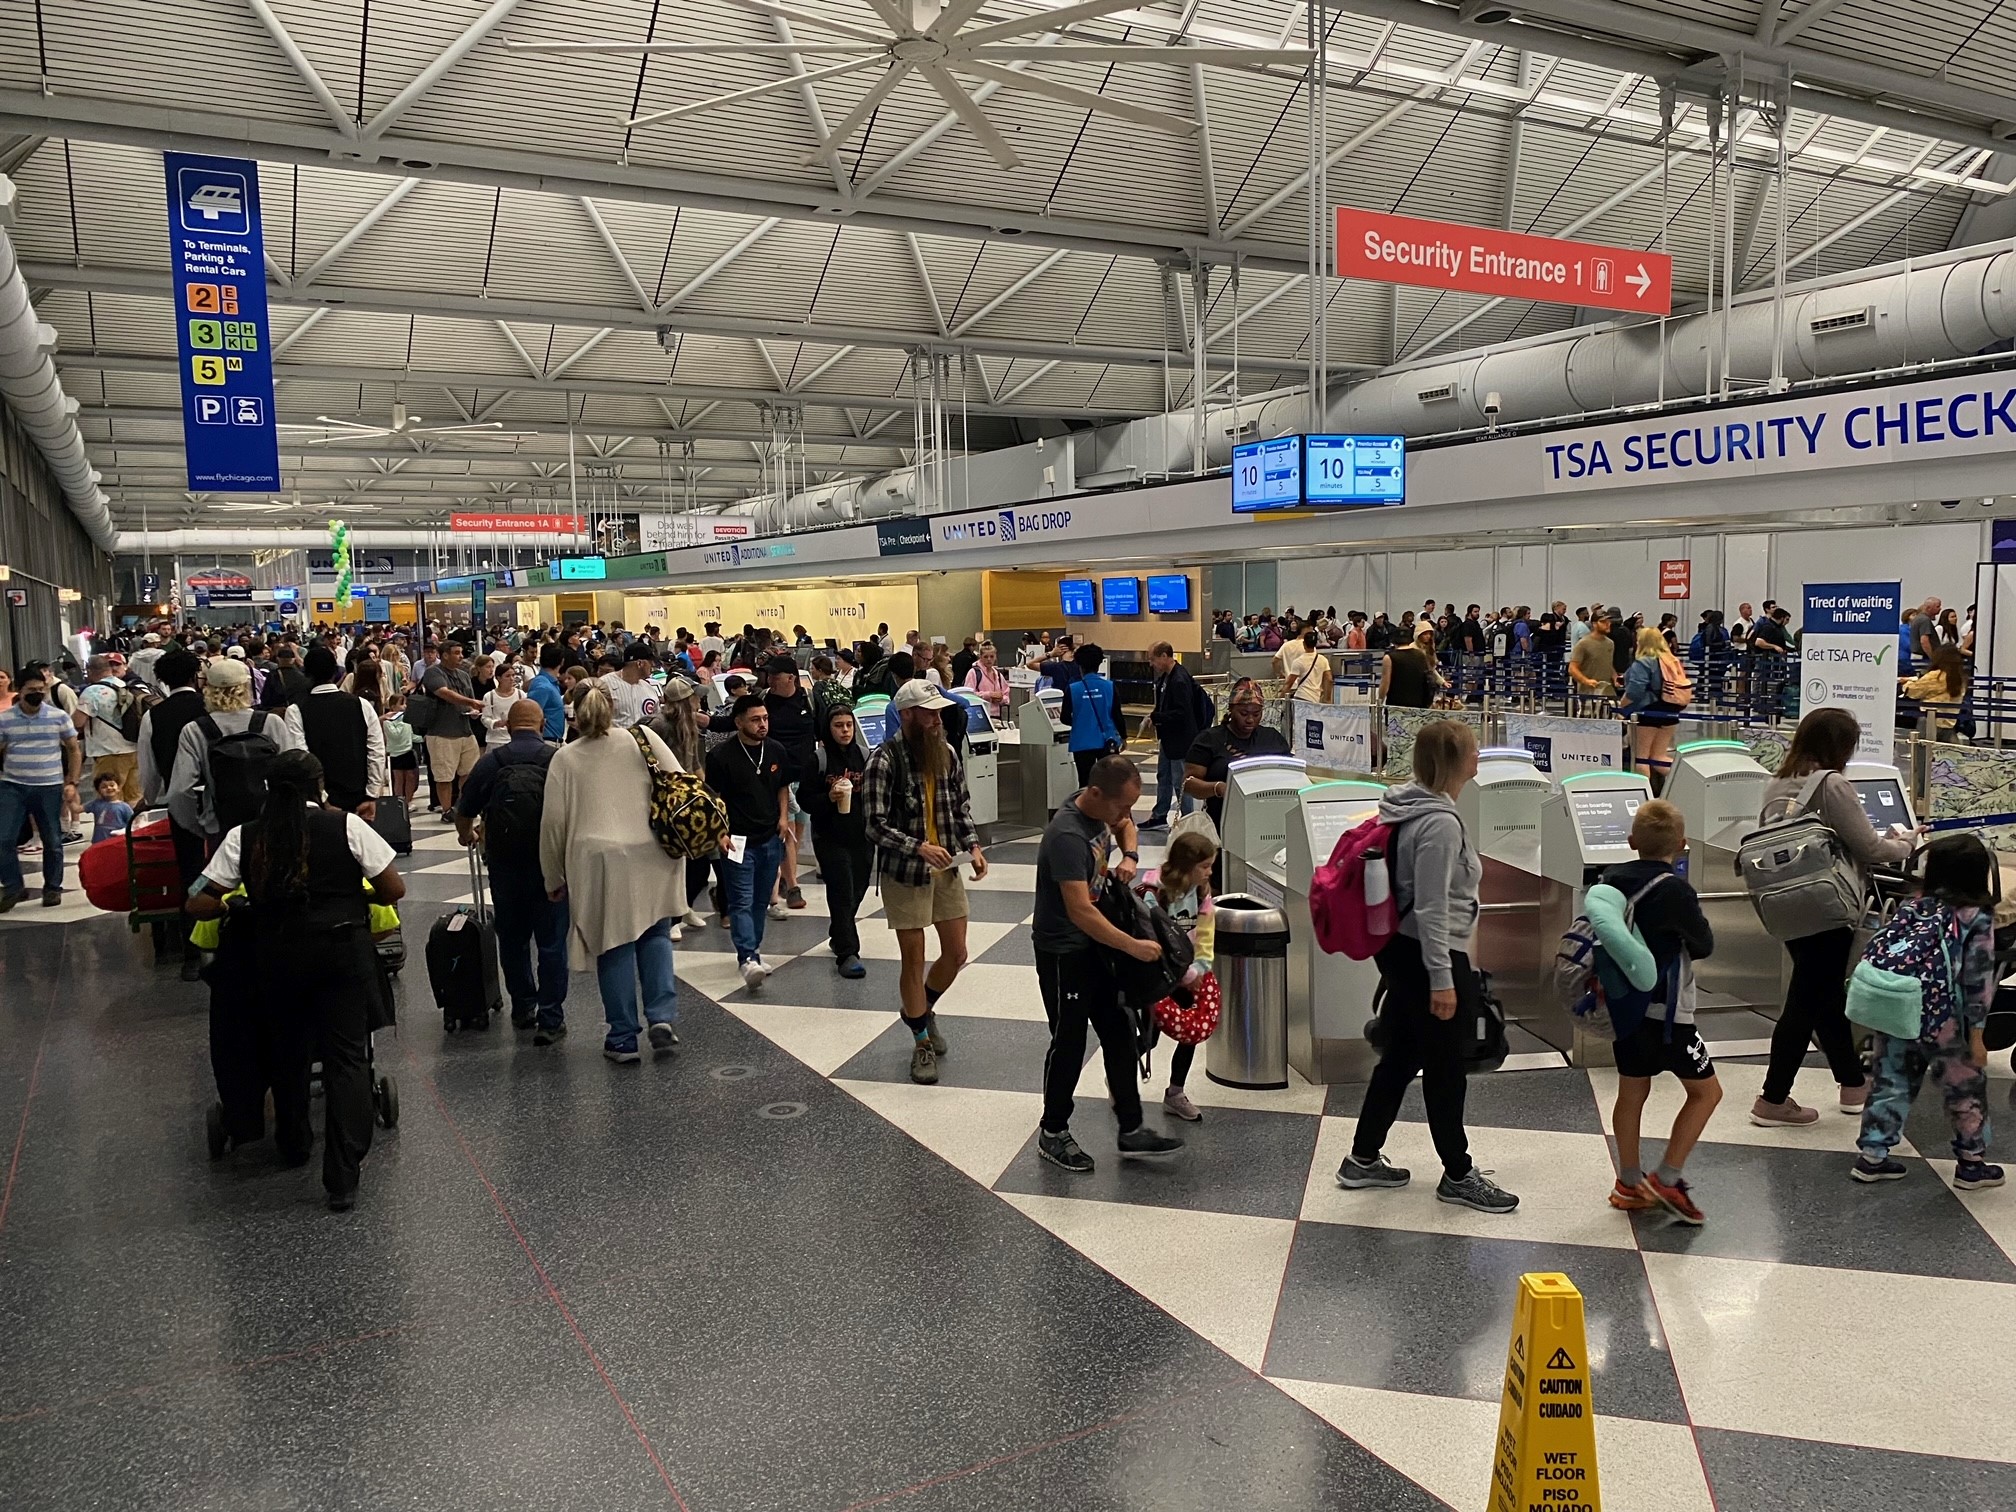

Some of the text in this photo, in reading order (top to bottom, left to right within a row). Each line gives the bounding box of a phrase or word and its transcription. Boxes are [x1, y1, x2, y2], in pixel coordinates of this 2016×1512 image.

[183, 240, 251, 254] To Terminals,
[184, 252, 235, 265] Parking &
[1363, 230, 1582, 286] Security Entrance 1
[185, 263, 246, 276] Rental Cars
[195, 287, 234, 308] 2 E
[226, 302, 235, 312] F
[197, 323, 253, 344] 3 G H
[228, 339, 254, 349] K L
[200, 359, 241, 380] 5 M
[201, 399, 221, 421] P
[1545, 387, 2016, 480] TSA SECURITY CHECK
[1278, 453, 1283, 463] 5
[1375, 450, 1381, 460] 5
[1319, 458, 1344, 480] 10
[195, 473, 273, 482] www.flychicago.com
[1241, 466, 1258, 487] 10
[1278, 481, 1283, 491] 5
[1375, 478, 1381, 488] 5
[456, 519, 493, 528] Security
[495, 519, 535, 528] Entrance
[943, 511, 1071, 541] UNITED BAG DROP
[879, 537, 888, 546] TSA
[899, 534, 926, 545] Checkpoint
[704, 551, 731, 564] UNITED
[740, 546, 767, 559] ADDITIONA
[311, 560, 375, 568] UNED
[1809, 596, 1893, 610] Tired of waiting
[697, 609, 716, 617] UNITED
[756, 608, 778, 617] UNITED
[829, 607, 857, 617] UNITED
[1833, 611, 1871, 622] in line?
[1807, 648, 1873, 662] Get TSA Pre
[1527, 741, 1545, 751] Every
[1534, 751, 1547, 759] tion
[1561, 753, 1599, 763] UNITED
[1539, 1379, 1582, 1395] CAUTION
[1539, 1403, 1582, 1418] CUIDADO
[1505, 1425, 1516, 1450] WET
[1501, 1435, 1517, 1471] FLOOR
[1544, 1453, 1577, 1464] WET
[1501, 1458, 1513, 1485] PISO
[1536, 1468, 1585, 1480] FLOOR
[1494, 1465, 1516, 1508] MOJADO
[1543, 1489, 1578, 1500] PISO
[1529, 1504, 1592, 1512] MOJADO
